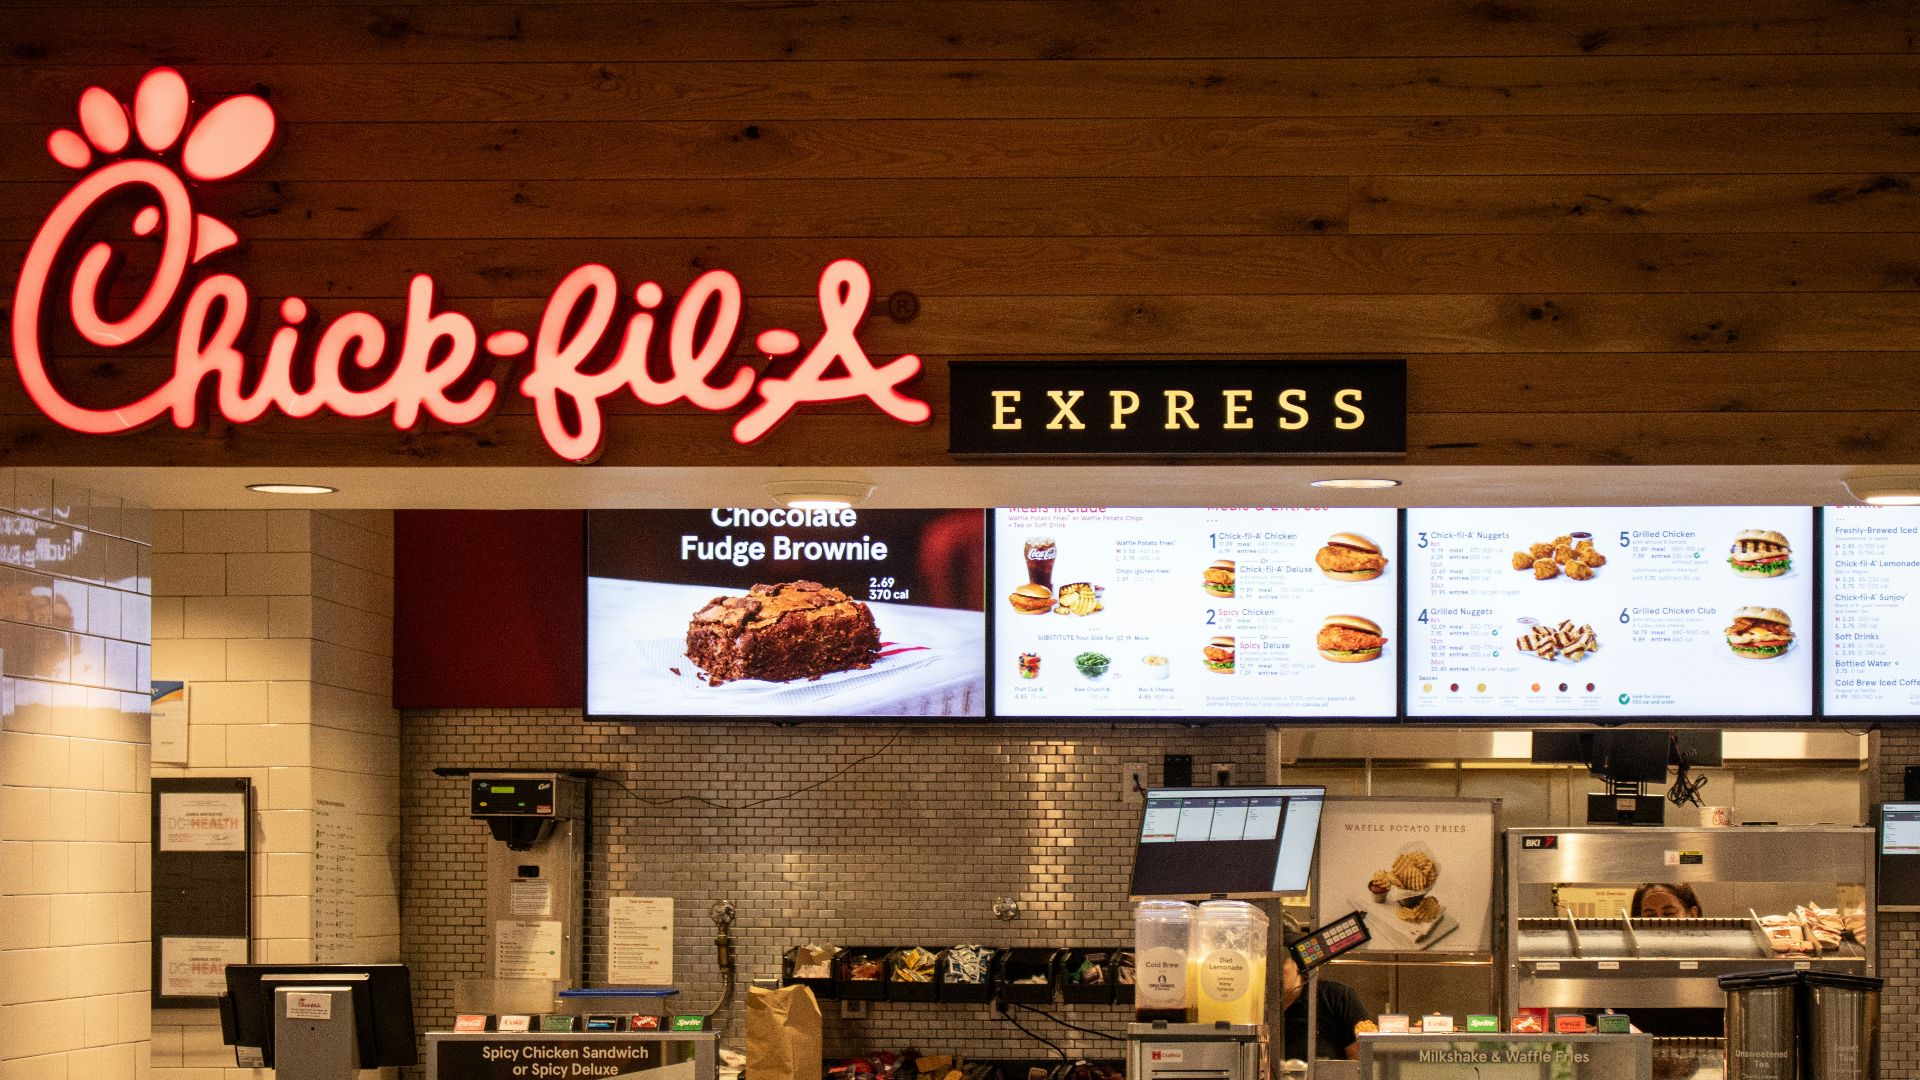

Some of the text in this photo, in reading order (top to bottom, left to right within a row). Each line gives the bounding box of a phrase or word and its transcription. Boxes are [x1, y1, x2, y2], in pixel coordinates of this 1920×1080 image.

[12, 159, 931, 461] Chick-fil-A
[992, 389, 1365, 431] EXPRESS
[711, 508, 857, 526] Chocolate
[1477, 532, 1510, 540] Nuggets
[1836, 526, 1918, 535] Freshly-Brewed Iced
[1210, 533, 1216, 548] 1
[1418, 532, 1428, 548] 3
[1620, 531, 1630, 548] 5
[681, 535, 888, 566] Fudge Brownie
[869, 577, 895, 588] 2.69
[869, 588, 909, 600] 370 cal
[1206, 609, 1216, 624] 2
[1418, 608, 1429, 624] 4
[1460, 608, 1492, 616] Nuggets
[1619, 608, 1630, 624] 6
[1240, 642, 1260, 650] Spicy
[1345, 824, 1384, 832] WAFFLE
[1390, 824, 1430, 832] POTATO
[1471, 1020, 1495, 1028] Sprite
[482, 1046, 648, 1060] Spicy Chicken Sandwich
[1420, 1050, 1590, 1062] Milkshake & Waffle Fries
[1736, 1049, 1788, 1058] Unsweetened
[513, 1063, 618, 1078] or Spicy Deluxe
[1753, 1060, 1770, 1068] Tea
